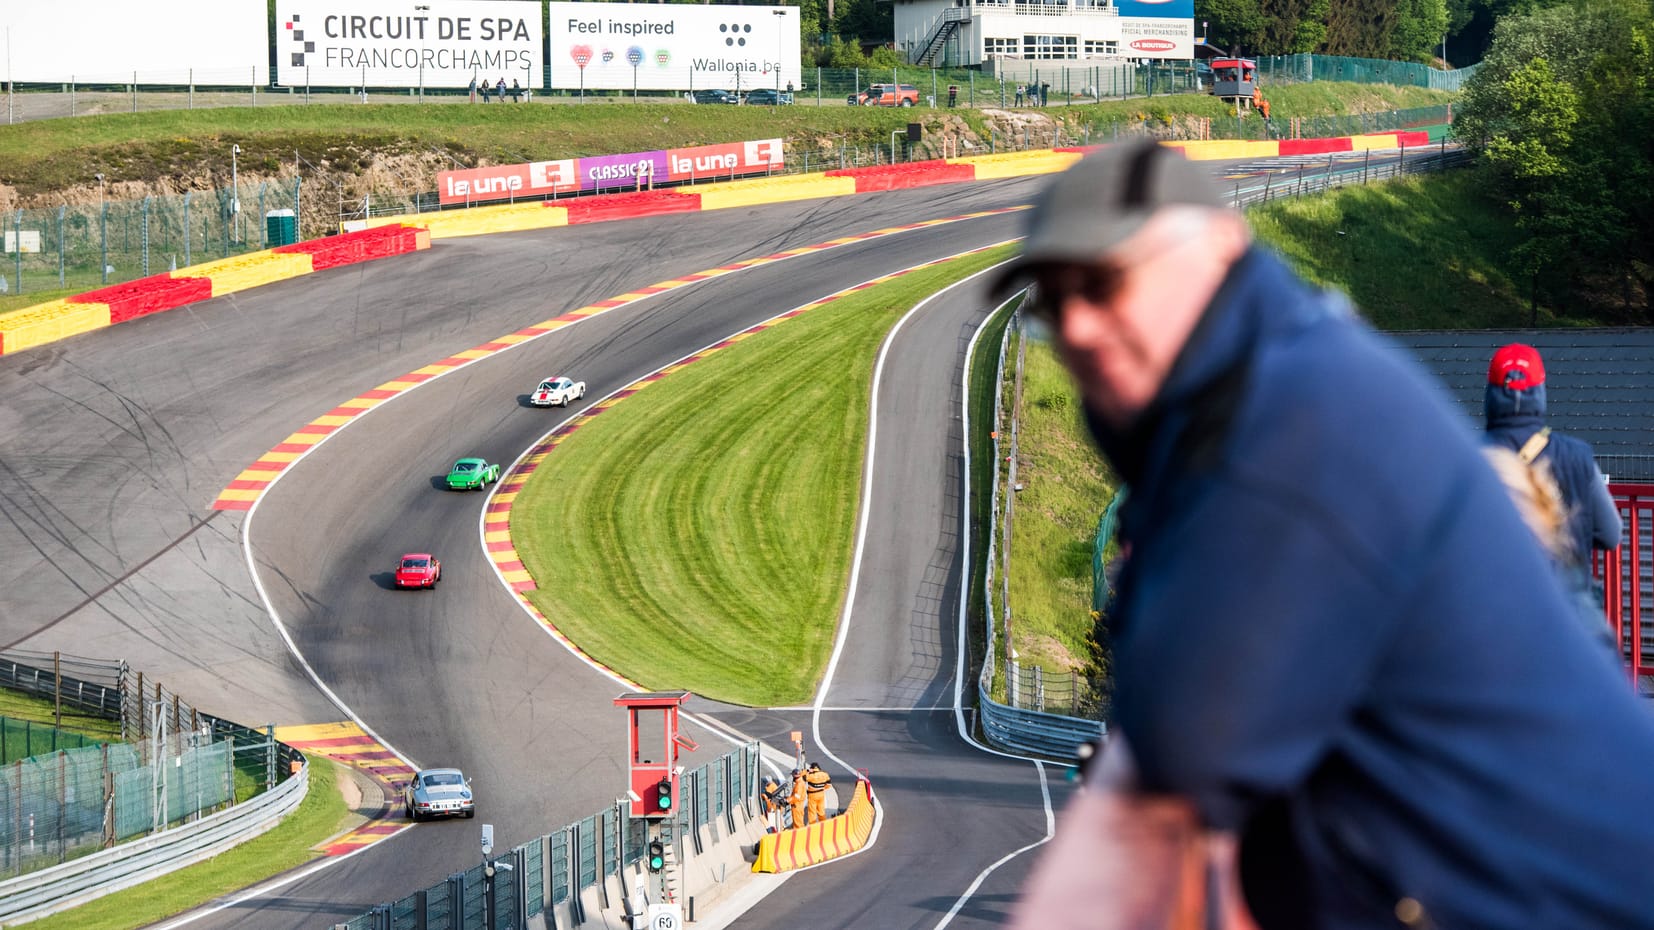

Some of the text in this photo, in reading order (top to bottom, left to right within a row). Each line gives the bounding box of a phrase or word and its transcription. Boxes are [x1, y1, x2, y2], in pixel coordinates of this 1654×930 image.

[324, 15, 531, 42] CIRCUIT DE SPA
[568, 18, 675, 37] Feel inspired
[326, 47, 532, 71] FRANCORCHAMPS
[692, 58, 782, 73] Wallonia.be
[670, 153, 738, 175] la une
[447, 174, 523, 197] la une
